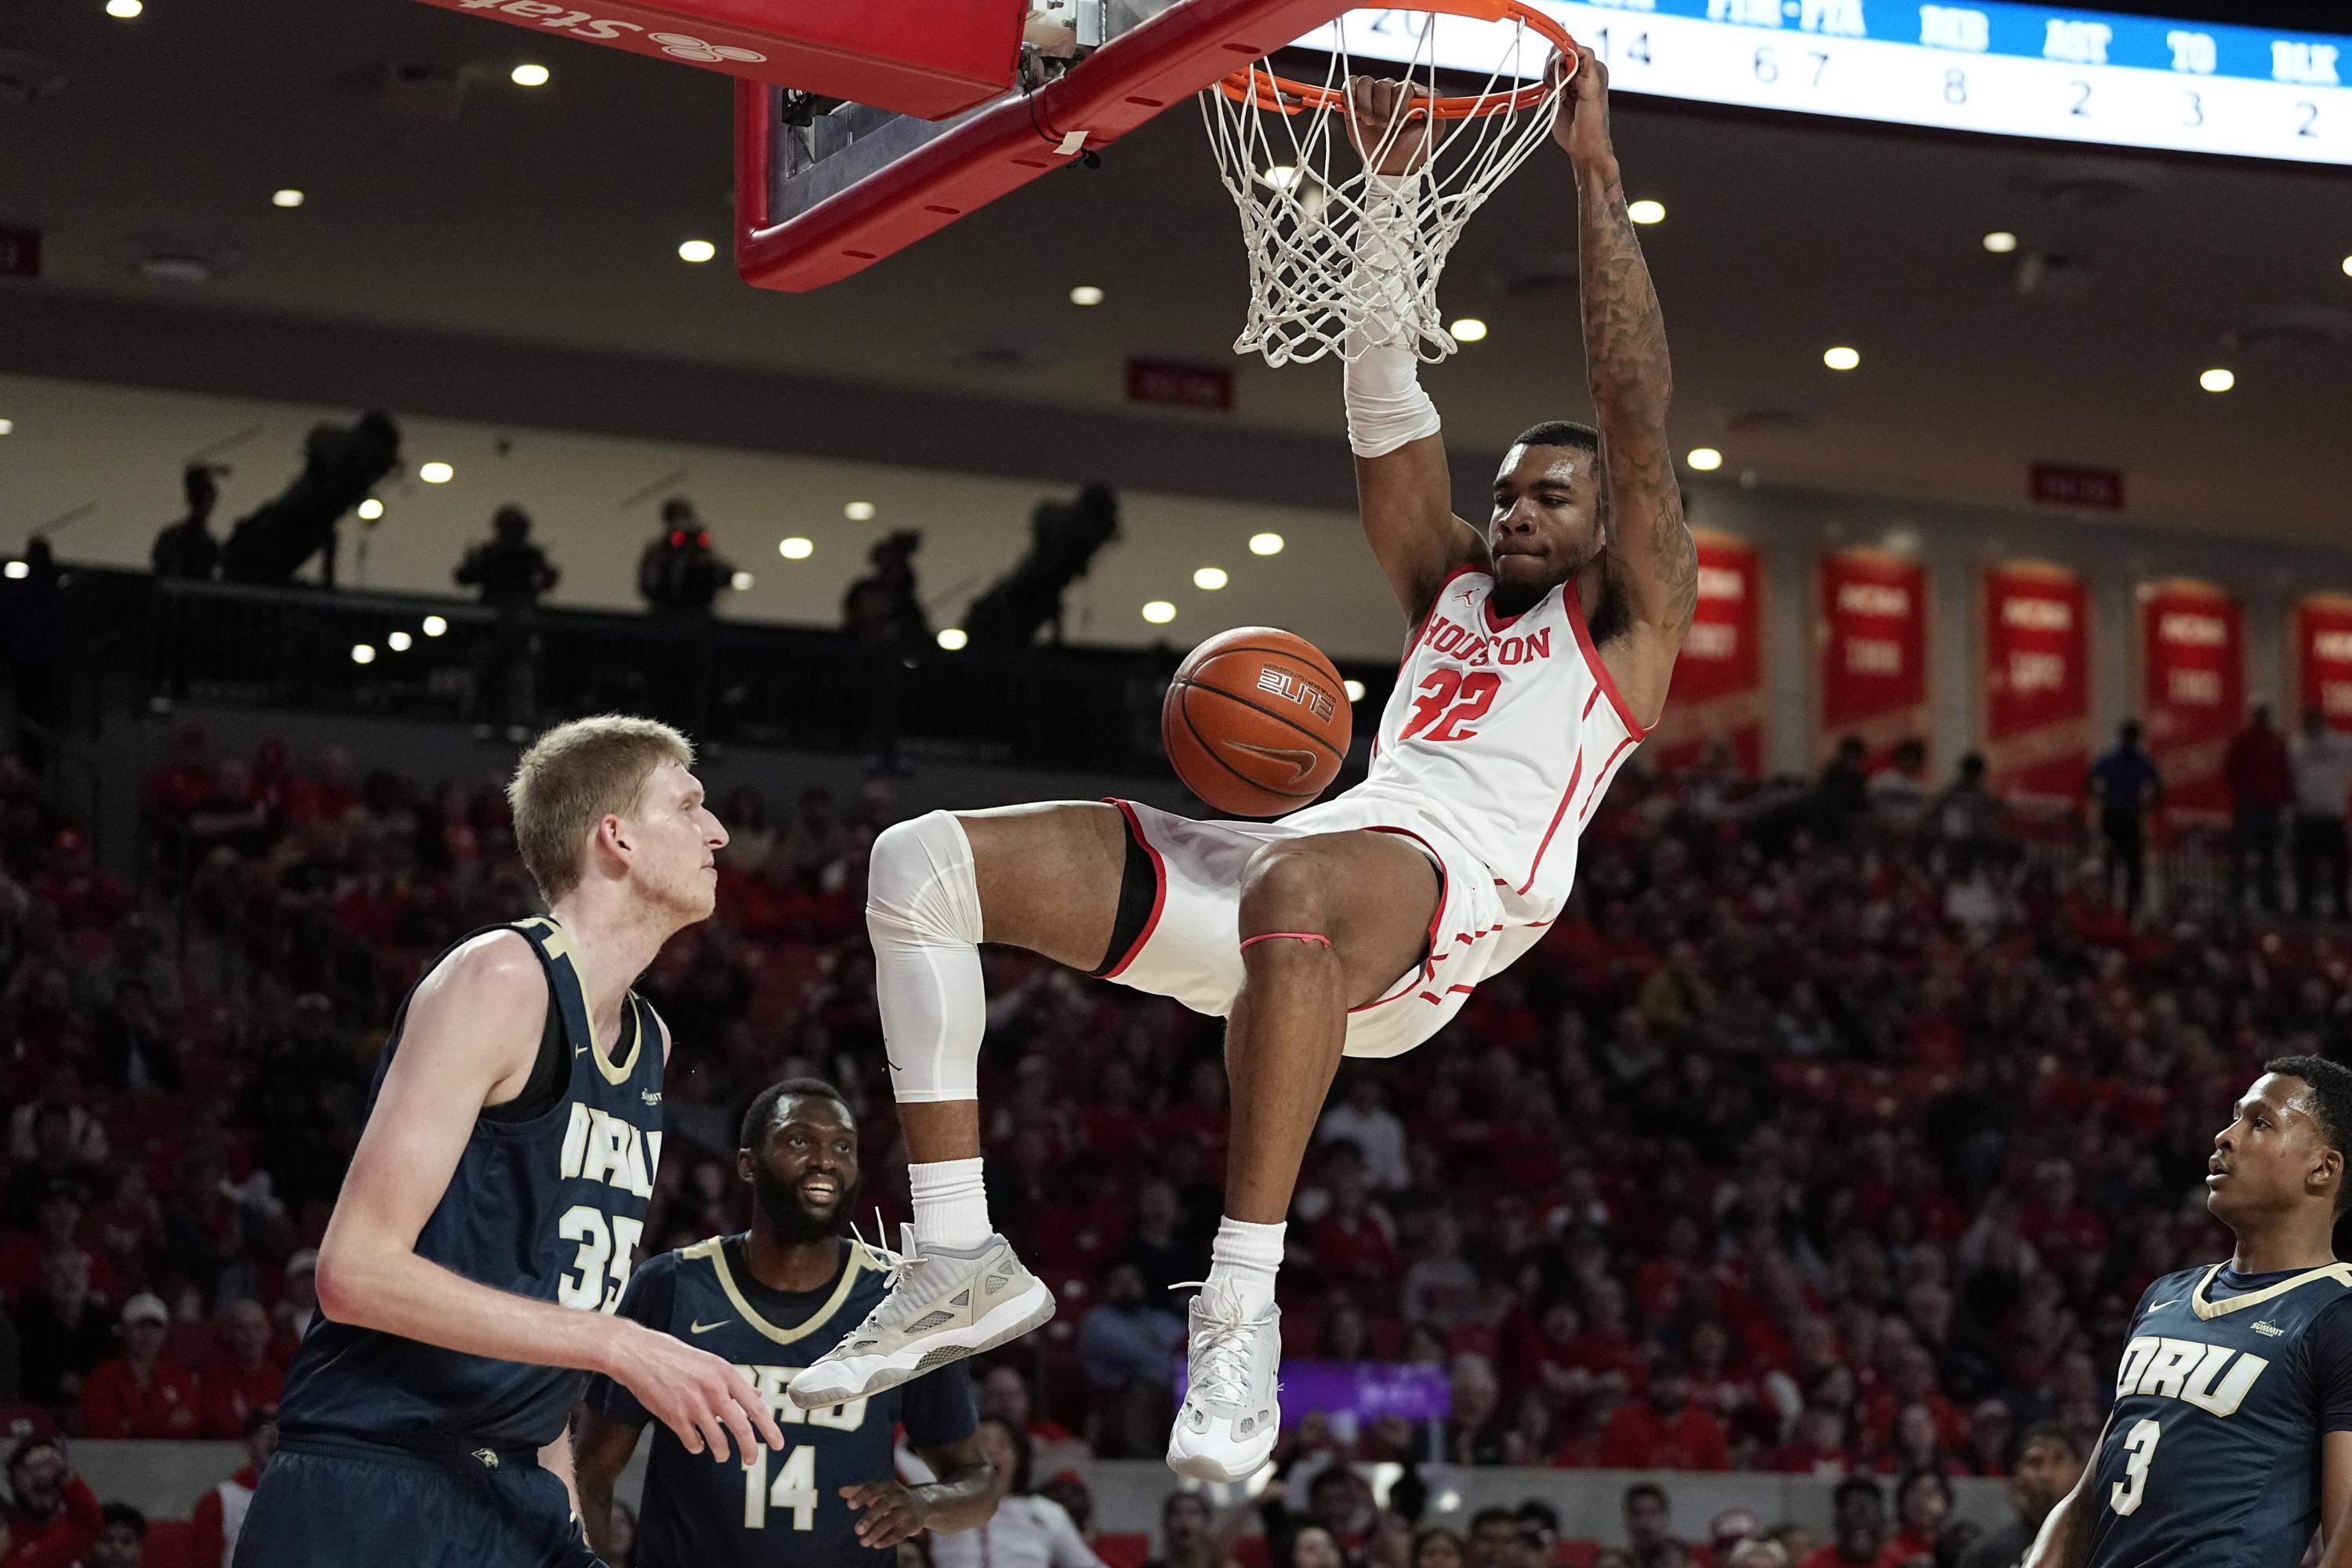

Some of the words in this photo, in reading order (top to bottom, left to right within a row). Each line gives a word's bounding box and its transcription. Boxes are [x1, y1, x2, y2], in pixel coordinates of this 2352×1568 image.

[1944, 68, 1966, 103] 8
[2070, 81, 2091, 117] 2
[2183, 90, 2203, 127] 3
[2296, 101, 2318, 138] 2
[1257, 668, 1336, 724] ELITE
[557, 1205, 644, 1316] 35
[2250, 1322, 2285, 1337] SUMMIT
[2116, 1336, 2269, 1417] ORU
[741, 1443, 818, 1530] 14
[2111, 1419, 2160, 1516] 3
